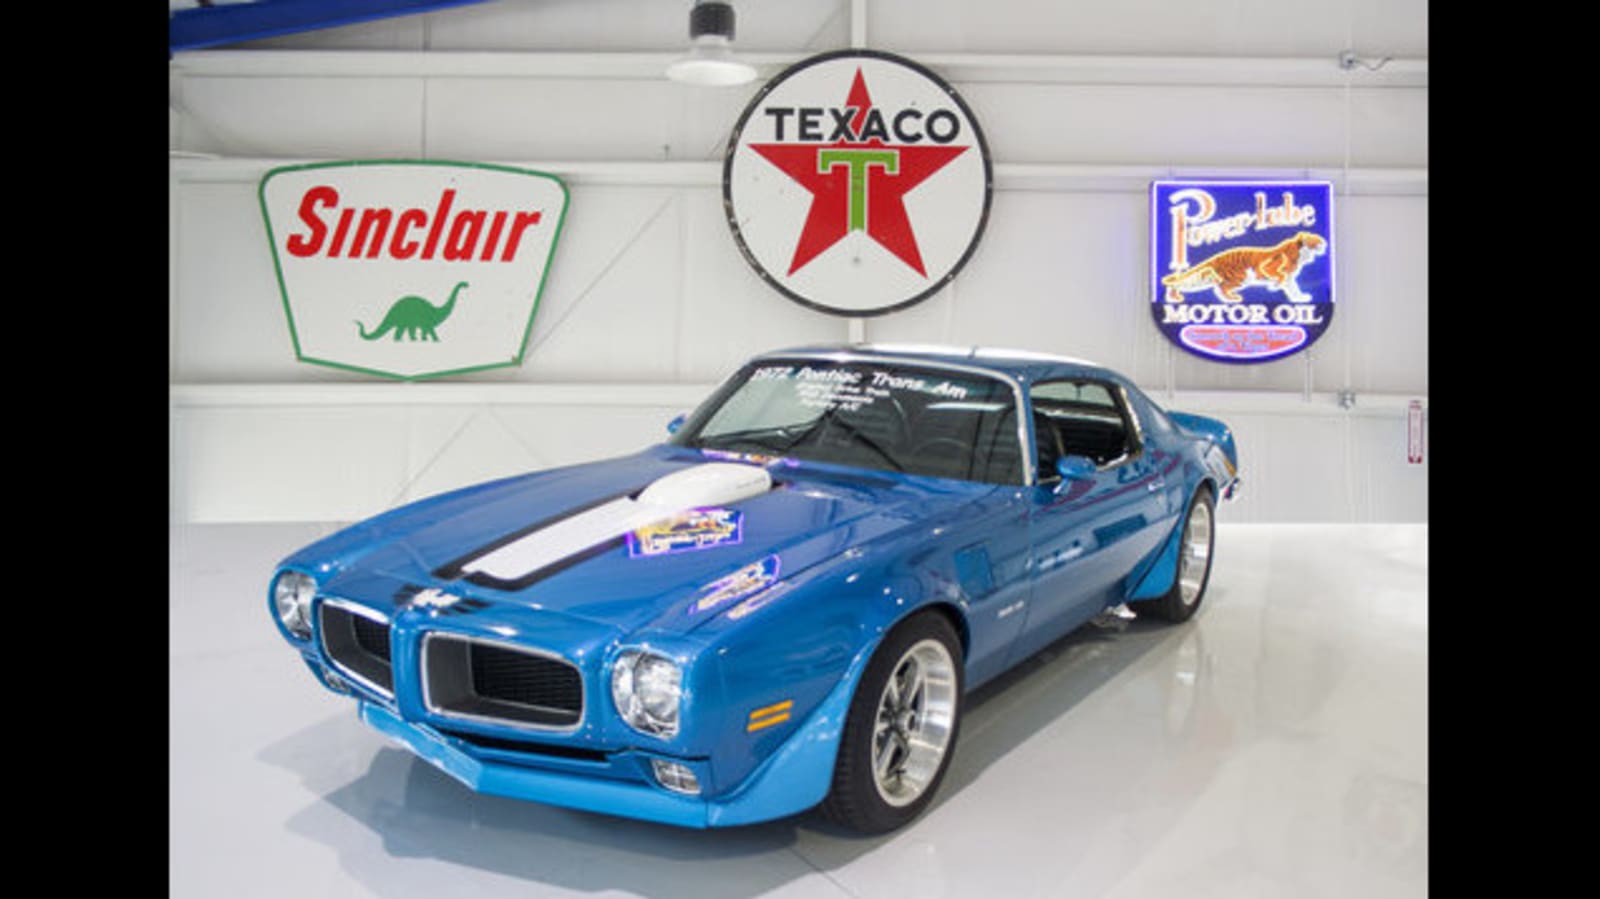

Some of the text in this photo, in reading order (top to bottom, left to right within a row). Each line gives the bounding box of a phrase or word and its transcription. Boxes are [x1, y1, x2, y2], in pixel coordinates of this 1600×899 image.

[764, 107, 960, 144] TEXACO
[818, 150, 899, 232] T
[286, 185, 543, 263] Sinclair
[1163, 304, 1324, 324] MOTOR OIL
[751, 366, 967, 399] 1972 Pontiac Trans Am
